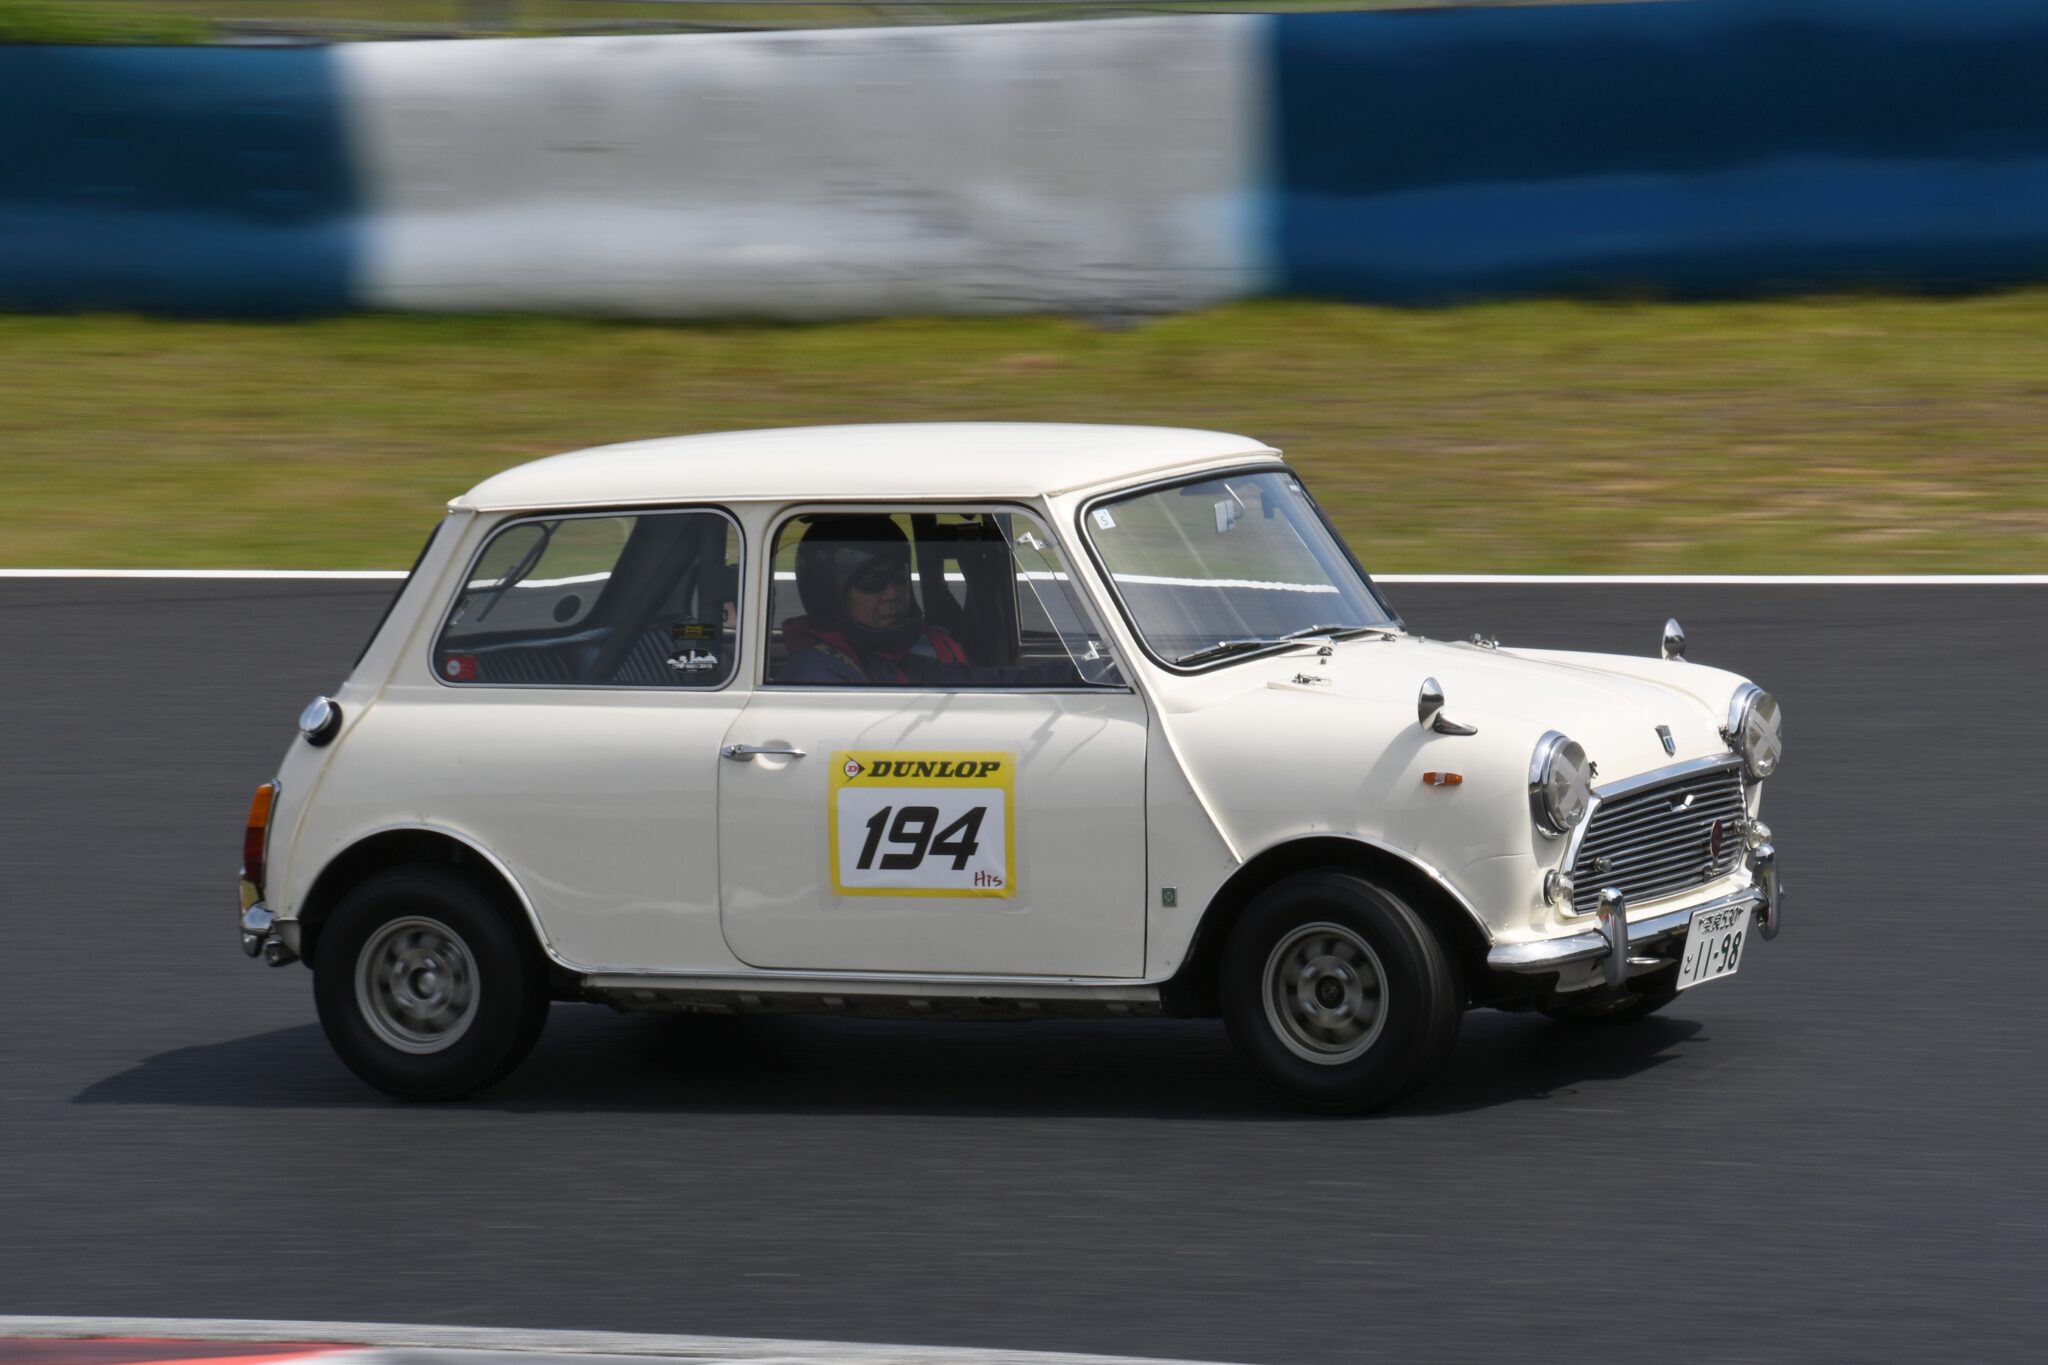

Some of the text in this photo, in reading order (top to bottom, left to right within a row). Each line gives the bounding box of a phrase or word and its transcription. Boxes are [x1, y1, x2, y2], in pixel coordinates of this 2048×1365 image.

[868, 761, 1001, 778] DUNLOP
[856, 806, 987, 871] 194
[974, 870, 1003, 888] His
[1693, 930, 1743, 982] 11-98
